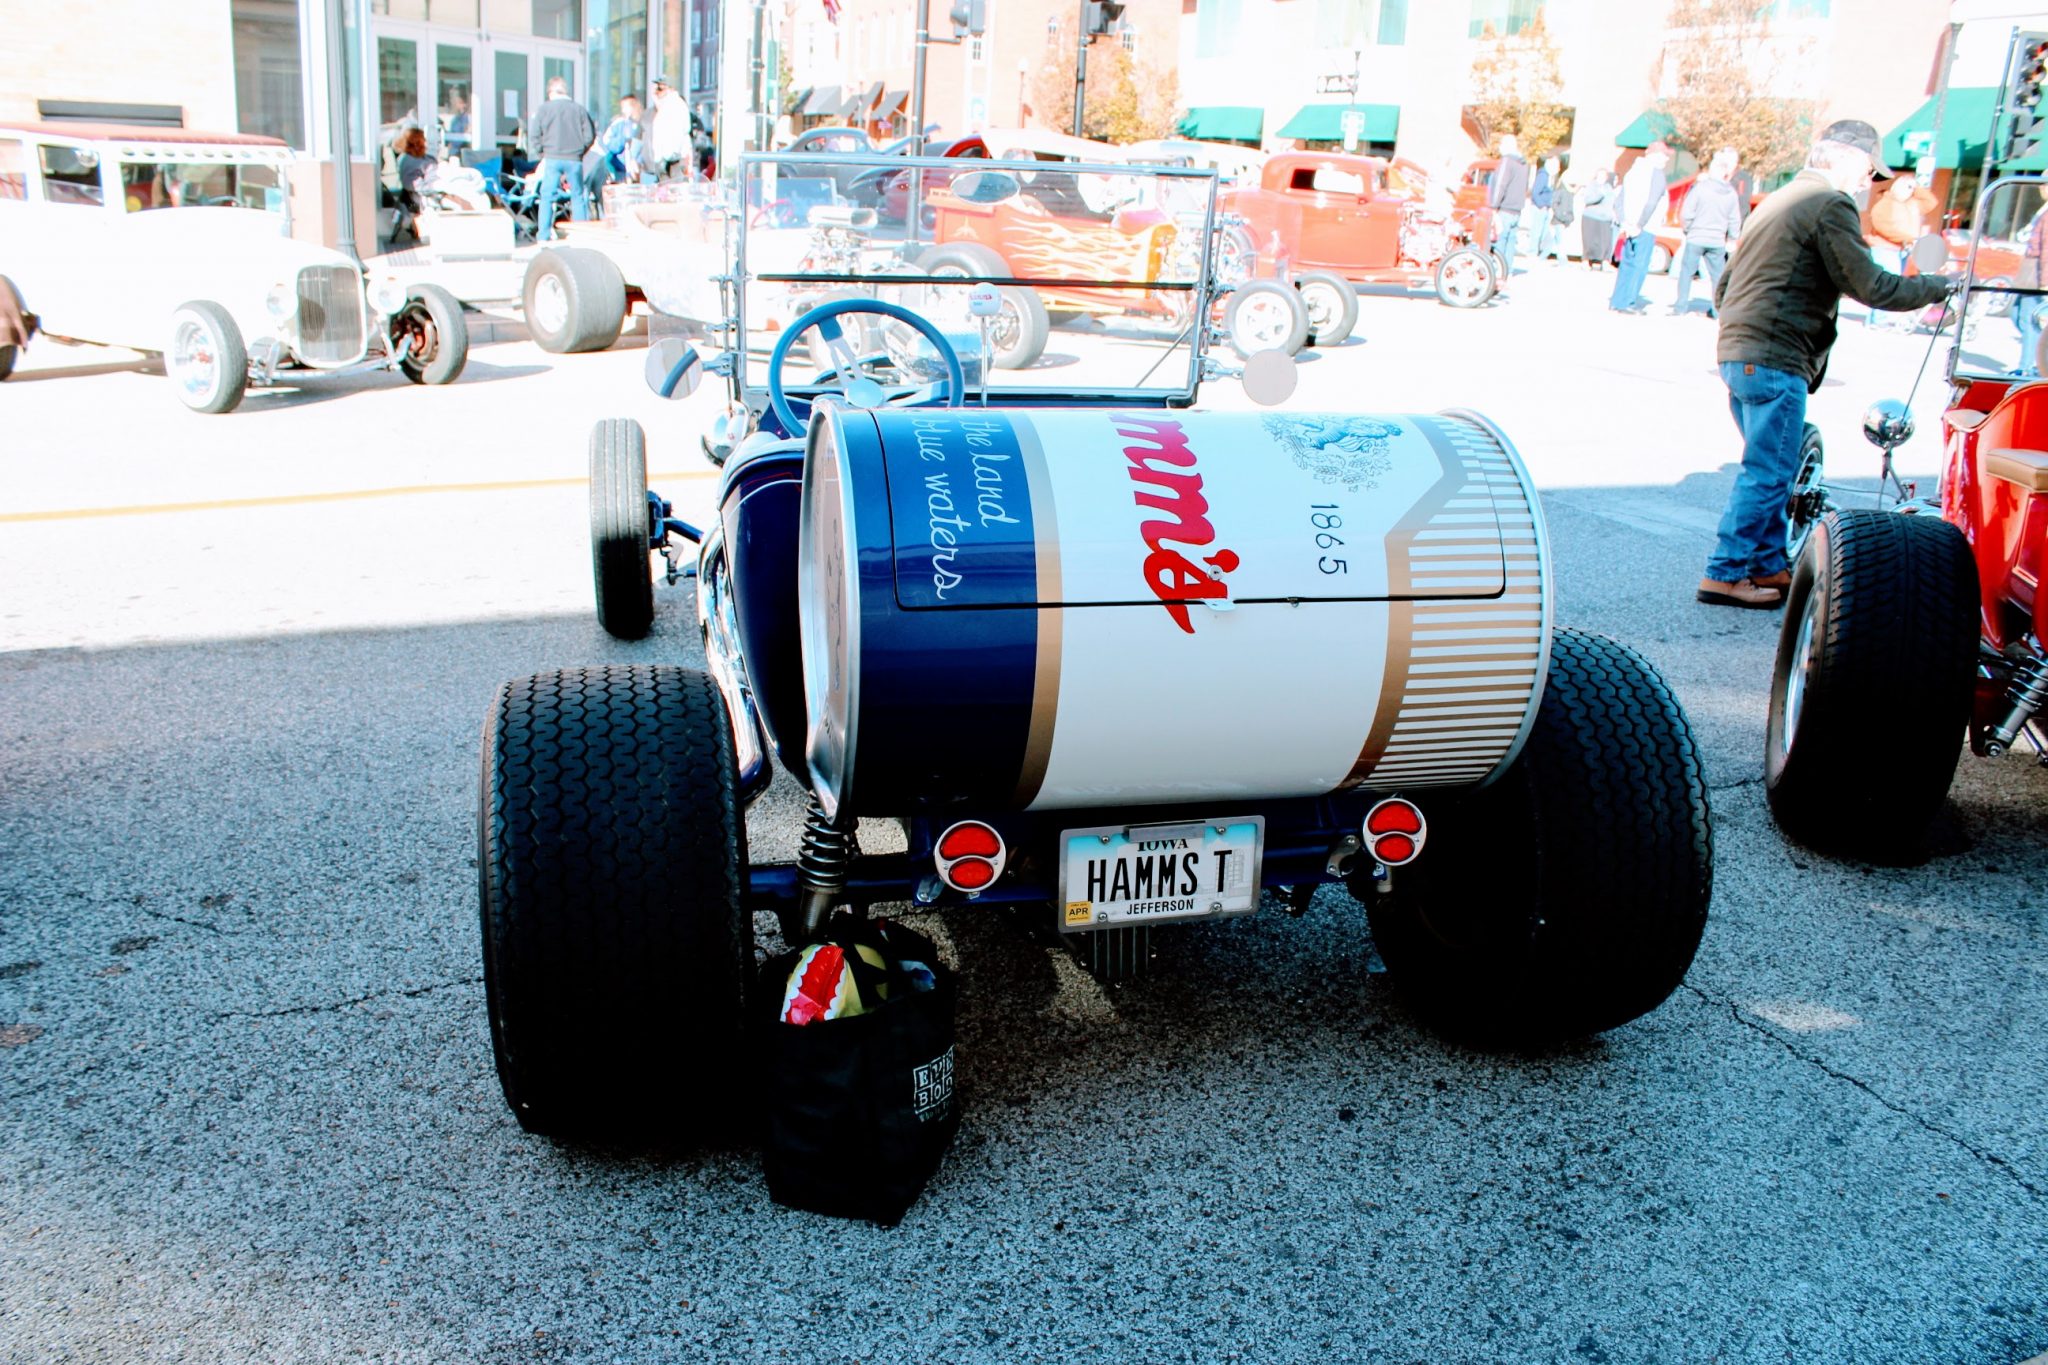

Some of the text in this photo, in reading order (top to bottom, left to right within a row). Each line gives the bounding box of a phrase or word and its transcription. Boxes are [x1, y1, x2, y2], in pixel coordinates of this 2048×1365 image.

[959, 420, 1020, 528] the land
[911, 418, 972, 600] blue waters
[1310, 503, 1348, 574] 1865
[1136, 838, 1189, 852] IOWA
[1087, 849, 1233, 904] HAMMS T
[1068, 907, 1089, 917] APR
[1126, 898, 1195, 916] JEFFERSON
